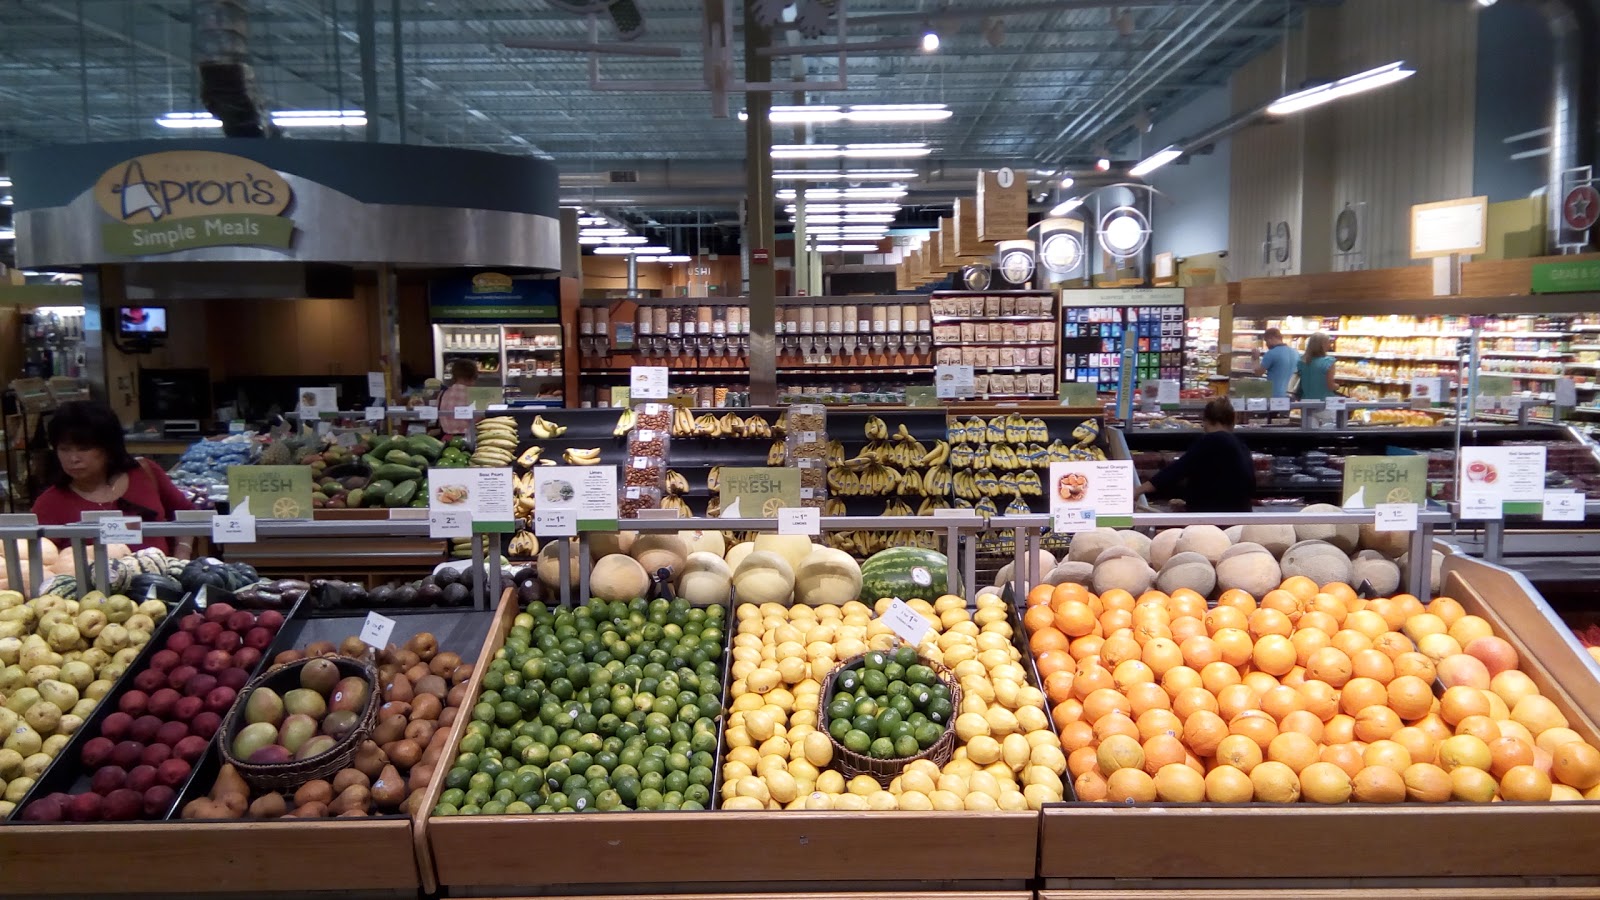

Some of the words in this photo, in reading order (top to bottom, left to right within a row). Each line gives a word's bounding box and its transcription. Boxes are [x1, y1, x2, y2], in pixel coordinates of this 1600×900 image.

[112, 160, 275, 221] Apron's
[133, 224, 196, 247] Simple
[204, 218, 260, 236] Meals
[1352, 469, 1409, 483] FRESH
[237, 478, 293, 493] FRESH
[727, 480, 782, 494] FRESH
